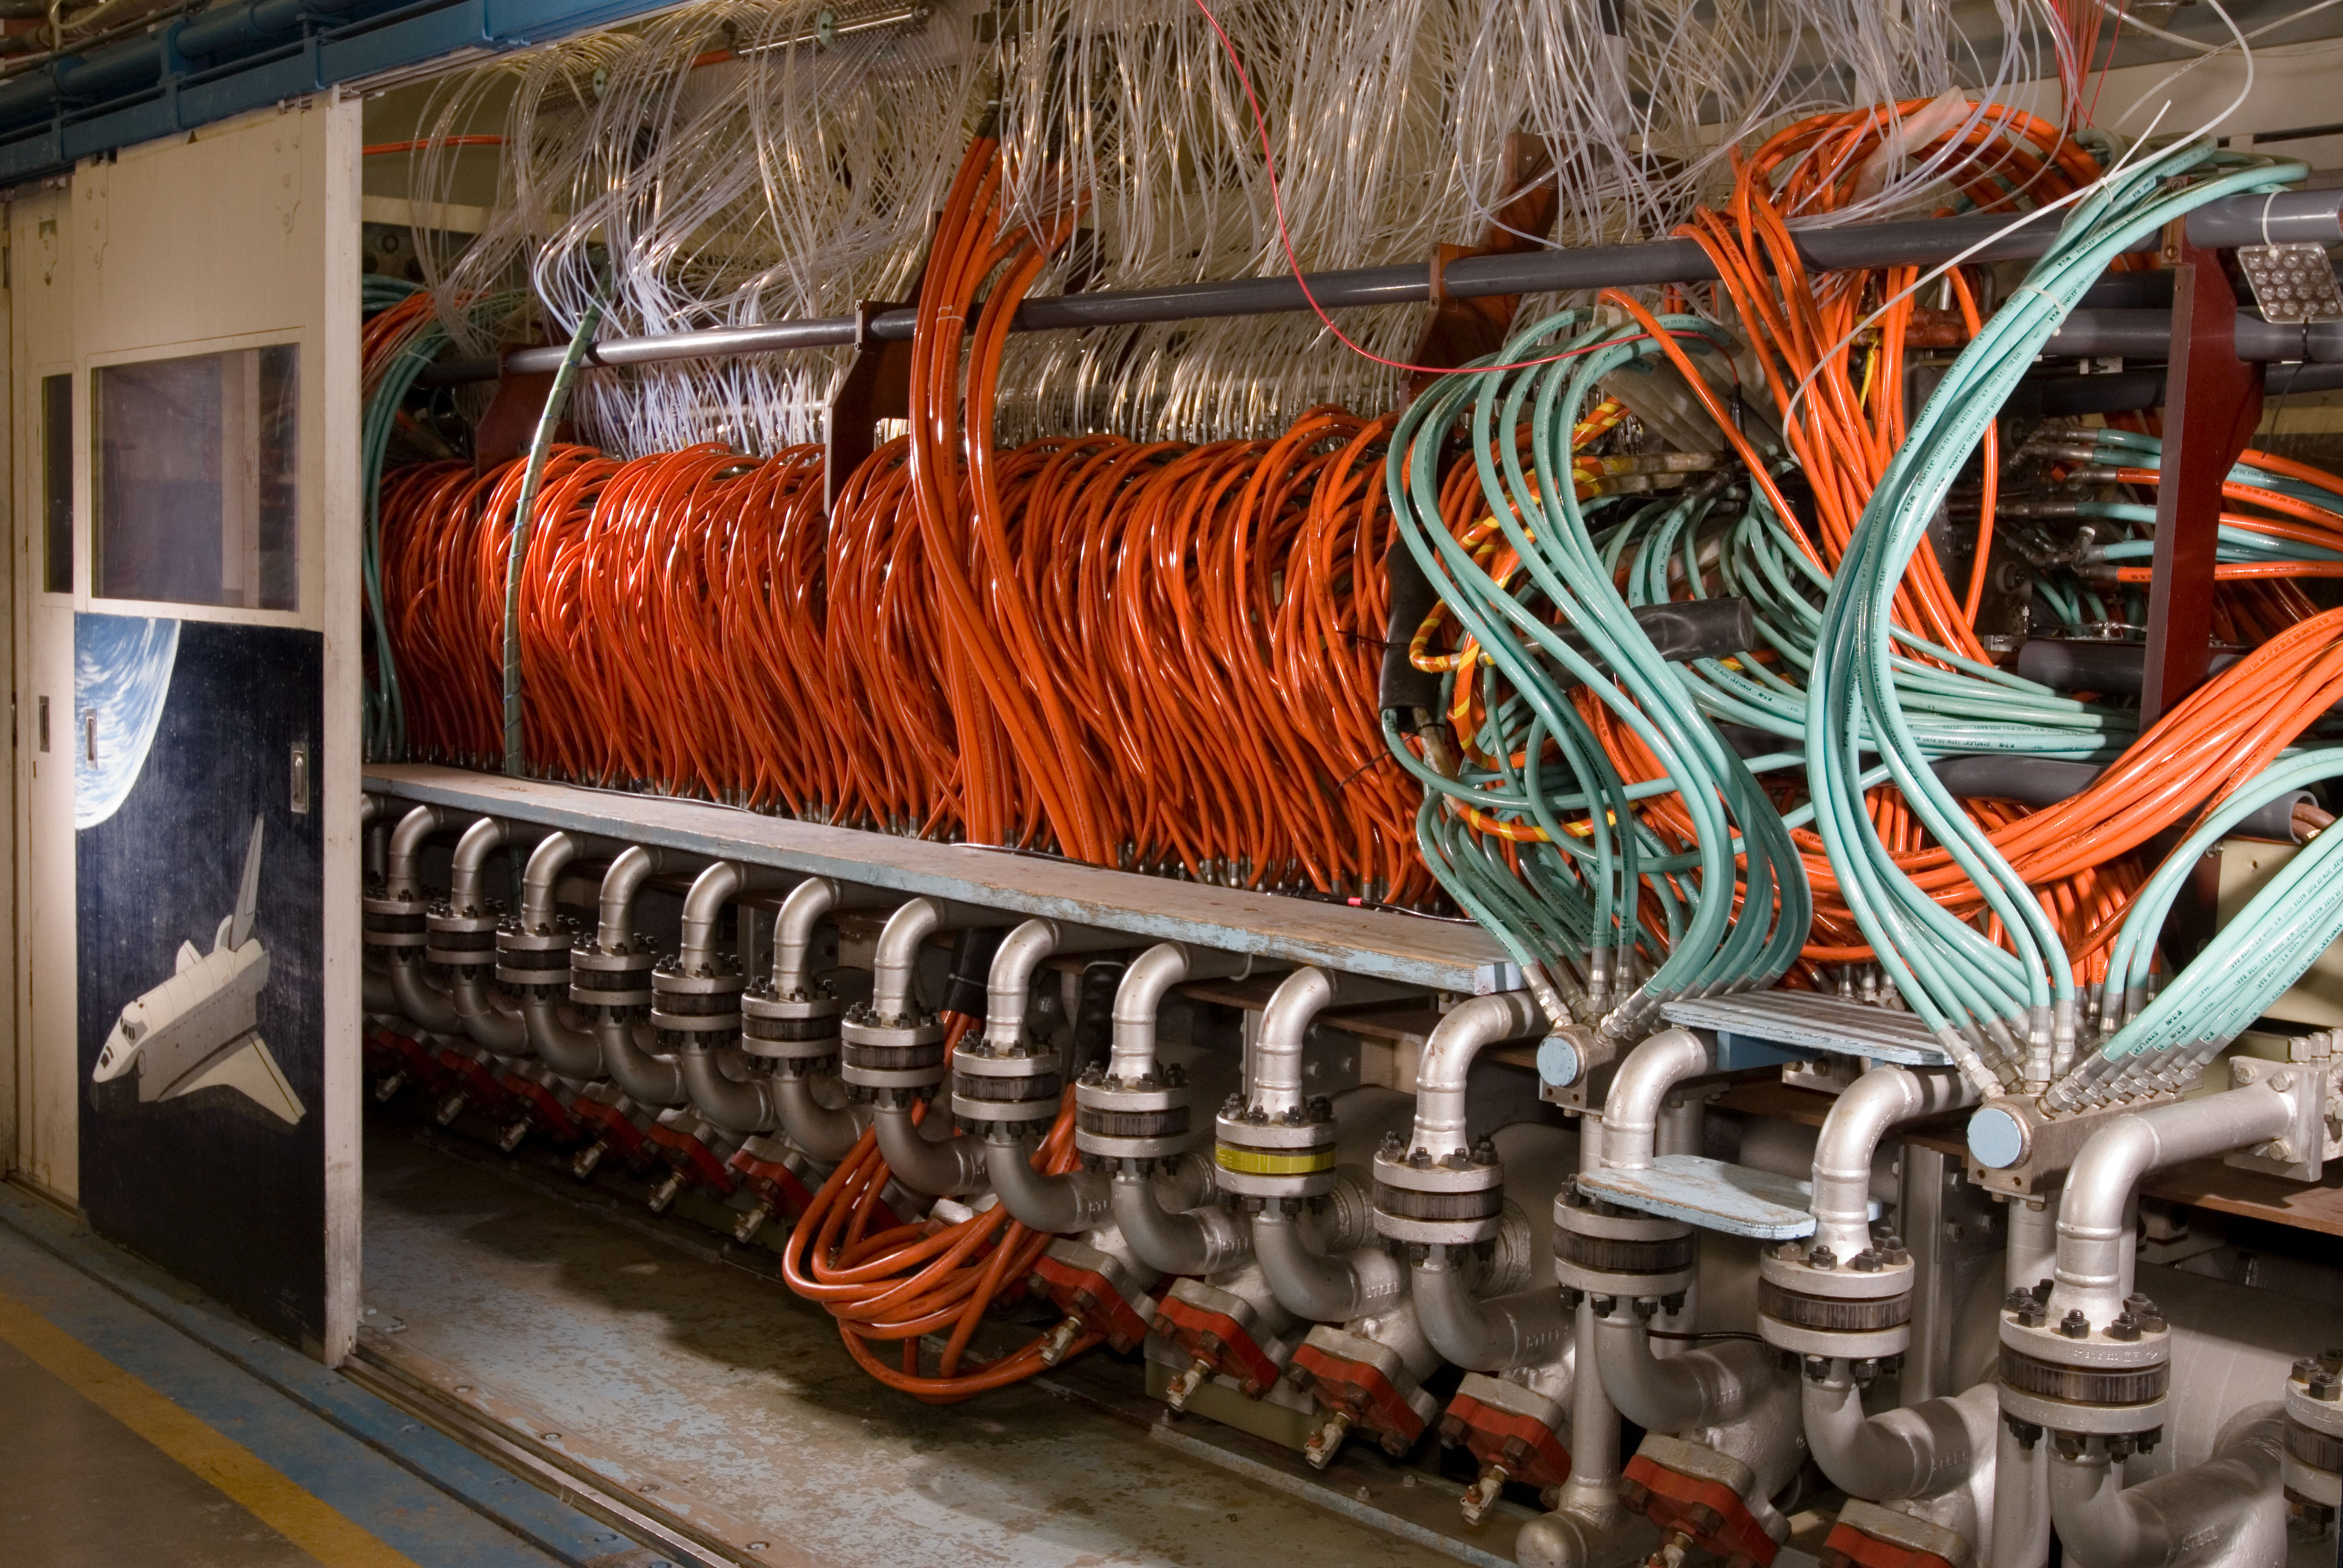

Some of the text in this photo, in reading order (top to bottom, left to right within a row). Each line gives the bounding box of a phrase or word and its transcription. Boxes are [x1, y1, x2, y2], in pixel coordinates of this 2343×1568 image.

[2321, 923, 2342, 949] SYNFLEX
[2289, 971, 2300, 984] PURE
[2272, 984, 2287, 999] WATER
